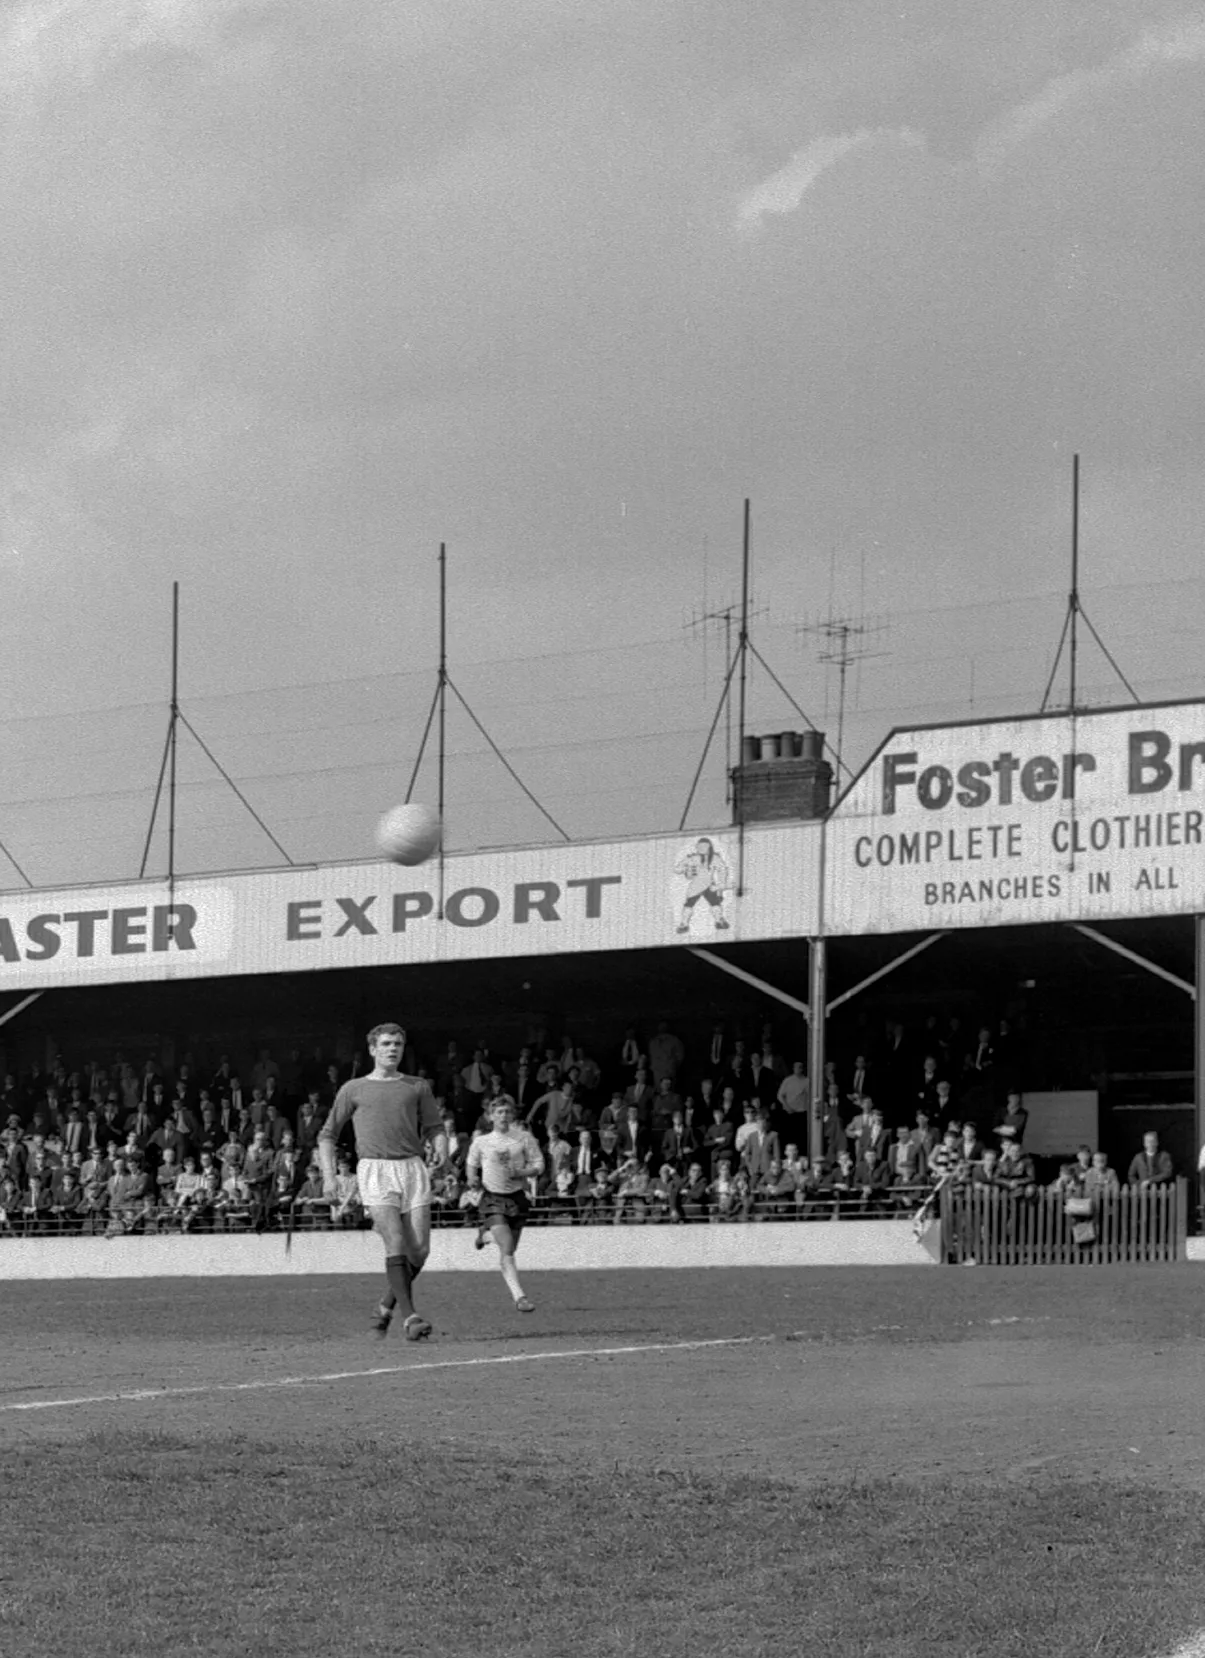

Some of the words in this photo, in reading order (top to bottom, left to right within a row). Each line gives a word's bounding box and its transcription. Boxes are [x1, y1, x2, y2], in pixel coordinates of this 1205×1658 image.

[882, 751, 1096, 815] Foster
[855, 823, 1023, 868] COMPLETE
[1052, 810, 1203, 853] CLOTHIER
[286, 875, 622, 941] EXPORT
[924, 874, 1061, 905] BRANCHES
[1088, 872, 1111, 893] IN
[1134, 866, 1179, 890] ALL
